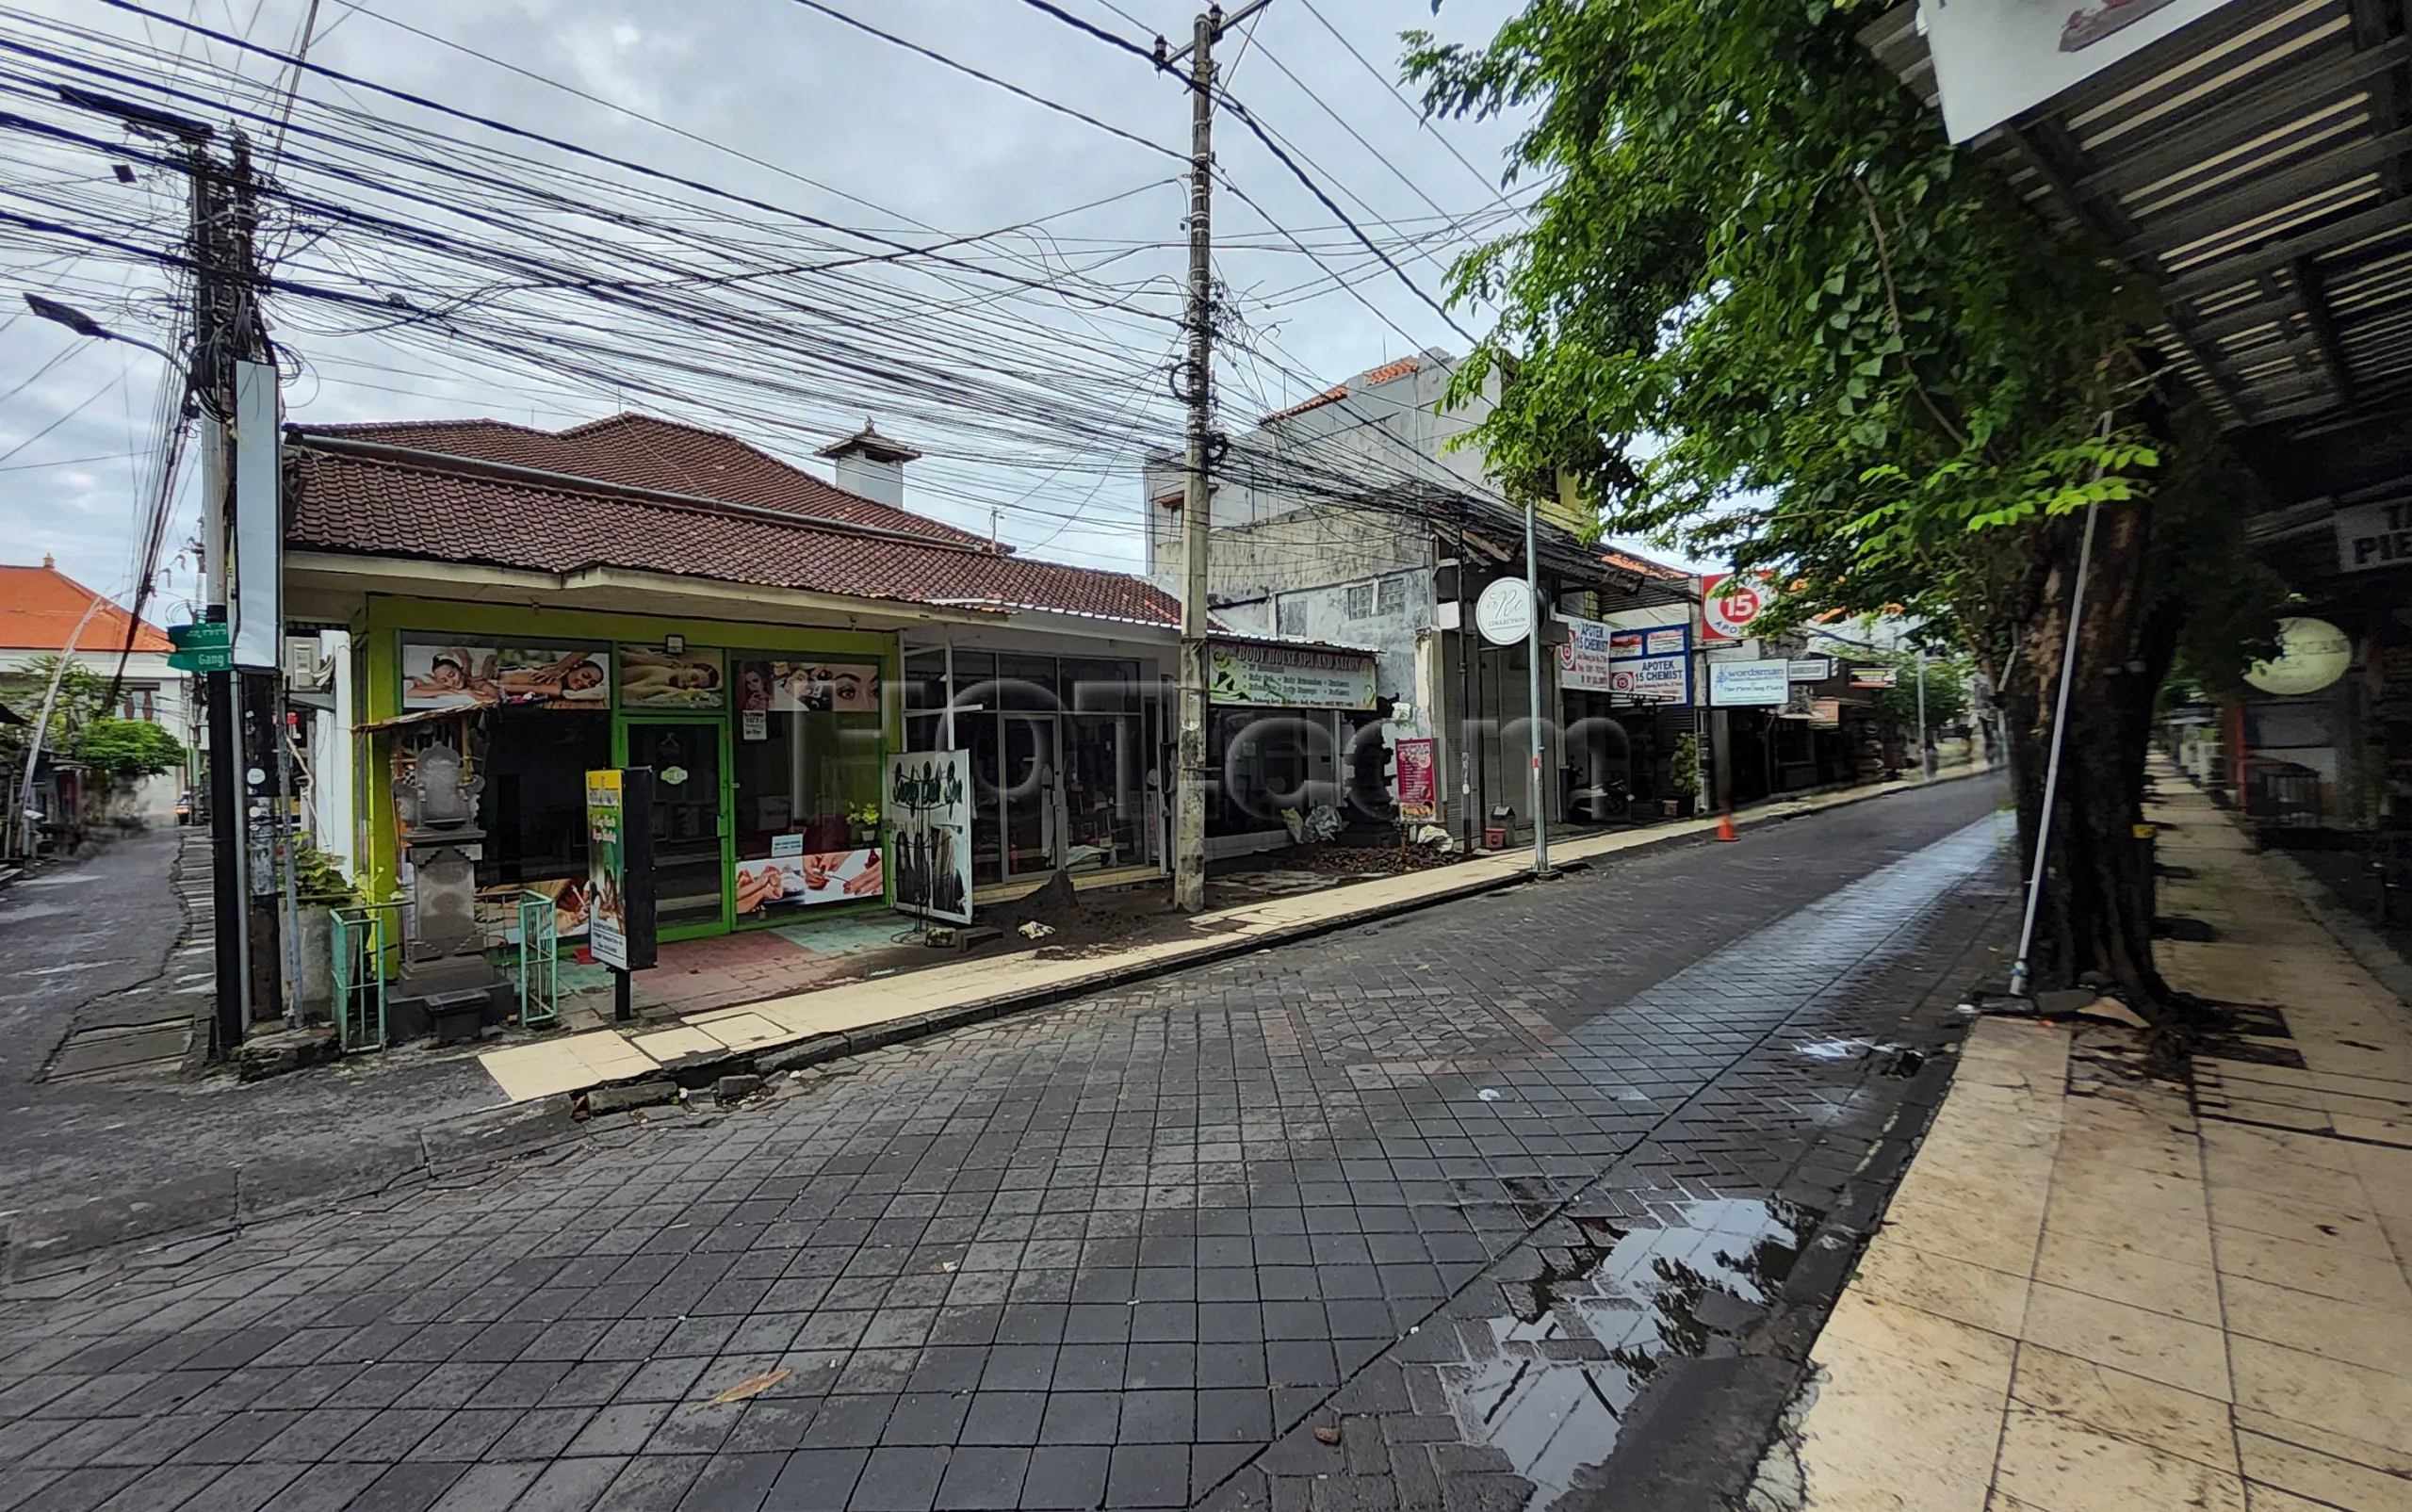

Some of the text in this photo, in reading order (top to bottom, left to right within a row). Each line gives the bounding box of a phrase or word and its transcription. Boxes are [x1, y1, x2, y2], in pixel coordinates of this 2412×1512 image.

[1725, 594, 1752, 616] 15
[1489, 617, 1526, 627] COLLECTION
[1581, 623, 1604, 638] APOTEK
[198, 654, 224, 667] Gang
[1237, 645, 1360, 672] BODY HOUSE SPA AND SALON
[1642, 660, 1674, 671] APOTEK
[1636, 670, 1682, 682] 15 CHEMIST
[1728, 668, 1785, 677] wordsman
